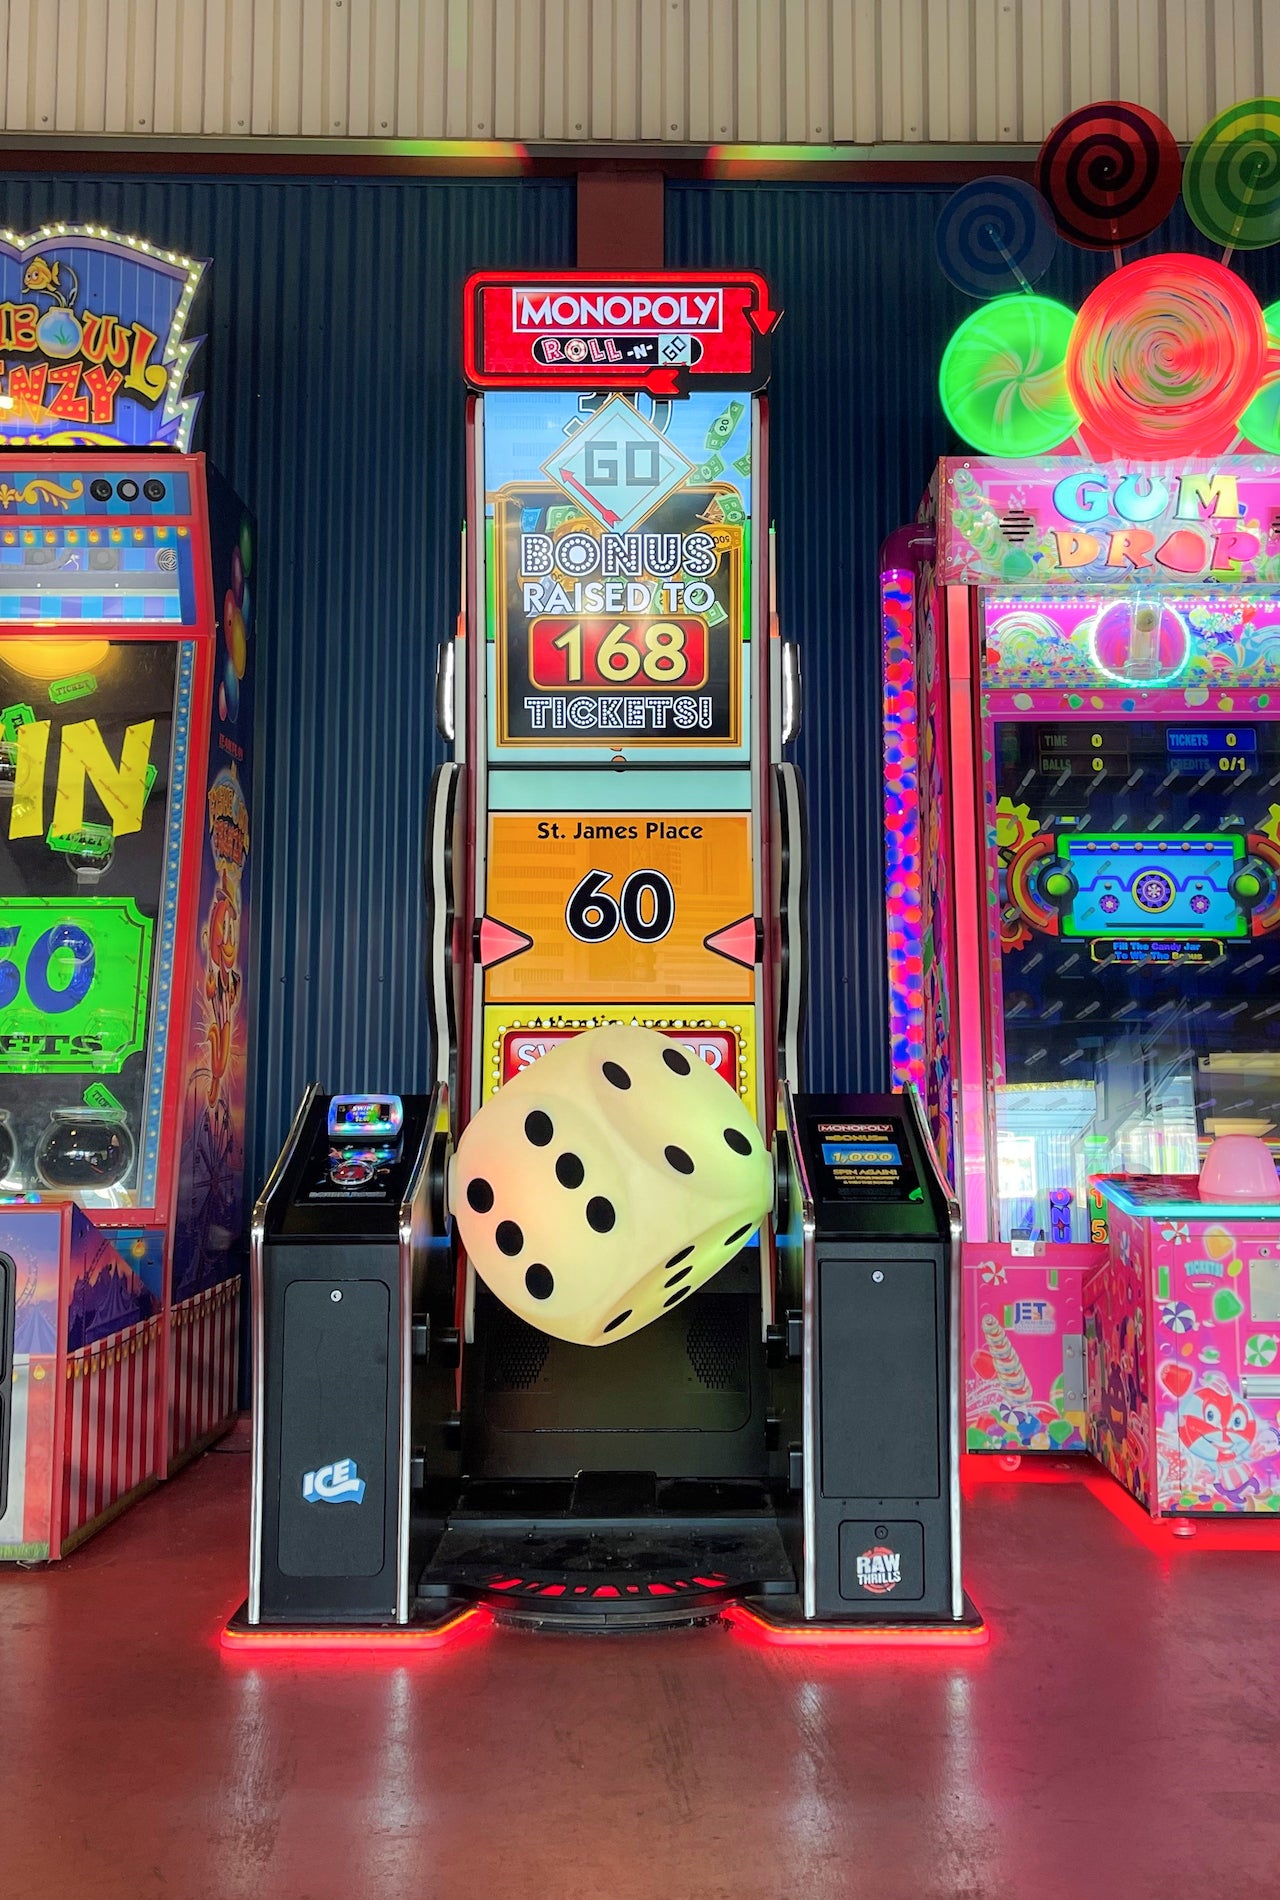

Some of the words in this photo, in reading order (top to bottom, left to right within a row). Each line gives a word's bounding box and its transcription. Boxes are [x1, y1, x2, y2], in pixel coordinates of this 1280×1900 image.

[520, 295, 717, 326] MONOPOLY
[541, 338, 623, 364] ROLL
[661, 335, 688, 362] GO
[0, 361, 123, 424] NZY
[584, 441, 660, 486] GO
[1052, 473, 1243, 523] GUM
[520, 533, 717, 577] BONUS
[1050, 529, 1260, 573] DROP
[523, 582, 652, 613] RAISED
[662, 582, 715, 613] TO
[554, 623, 688, 682] 168
[523, 697, 713, 729] TICKETS!
[1044, 735, 1068, 747] TIME
[1091, 734, 1103, 748] 0
[1169, 734, 1209, 747] TICKETS
[1226, 733, 1237, 747] 0
[1042, 759, 1071, 771] BALLS
[1092, 757, 1104, 771] 0
[1169, 759, 1211, 771] CREDITS
[1218, 757, 1246, 772] 0/1
[0, 719, 155, 840] IN
[537, 822, 566, 839] St.
[573, 822, 638, 840] James
[645, 822, 704, 839] Place
[565, 869, 676, 944] 60
[1112, 942, 1128, 951] Fill
[1129, 942, 1149, 951] The
[1151, 942, 1182, 952] Candy
[1184, 942, 1201, 951] Jar
[0, 1034, 103, 1055] ETS
[820, 1124, 890, 1132] MONOPOLY
[832, 1152, 894, 1164] 1,000
[1015, 1302, 1047, 1324] JET
[303, 1458, 364, 1503] ICE
[856, 1553, 900, 1574] RAW
[857, 1572, 901, 1585] THRILLS
